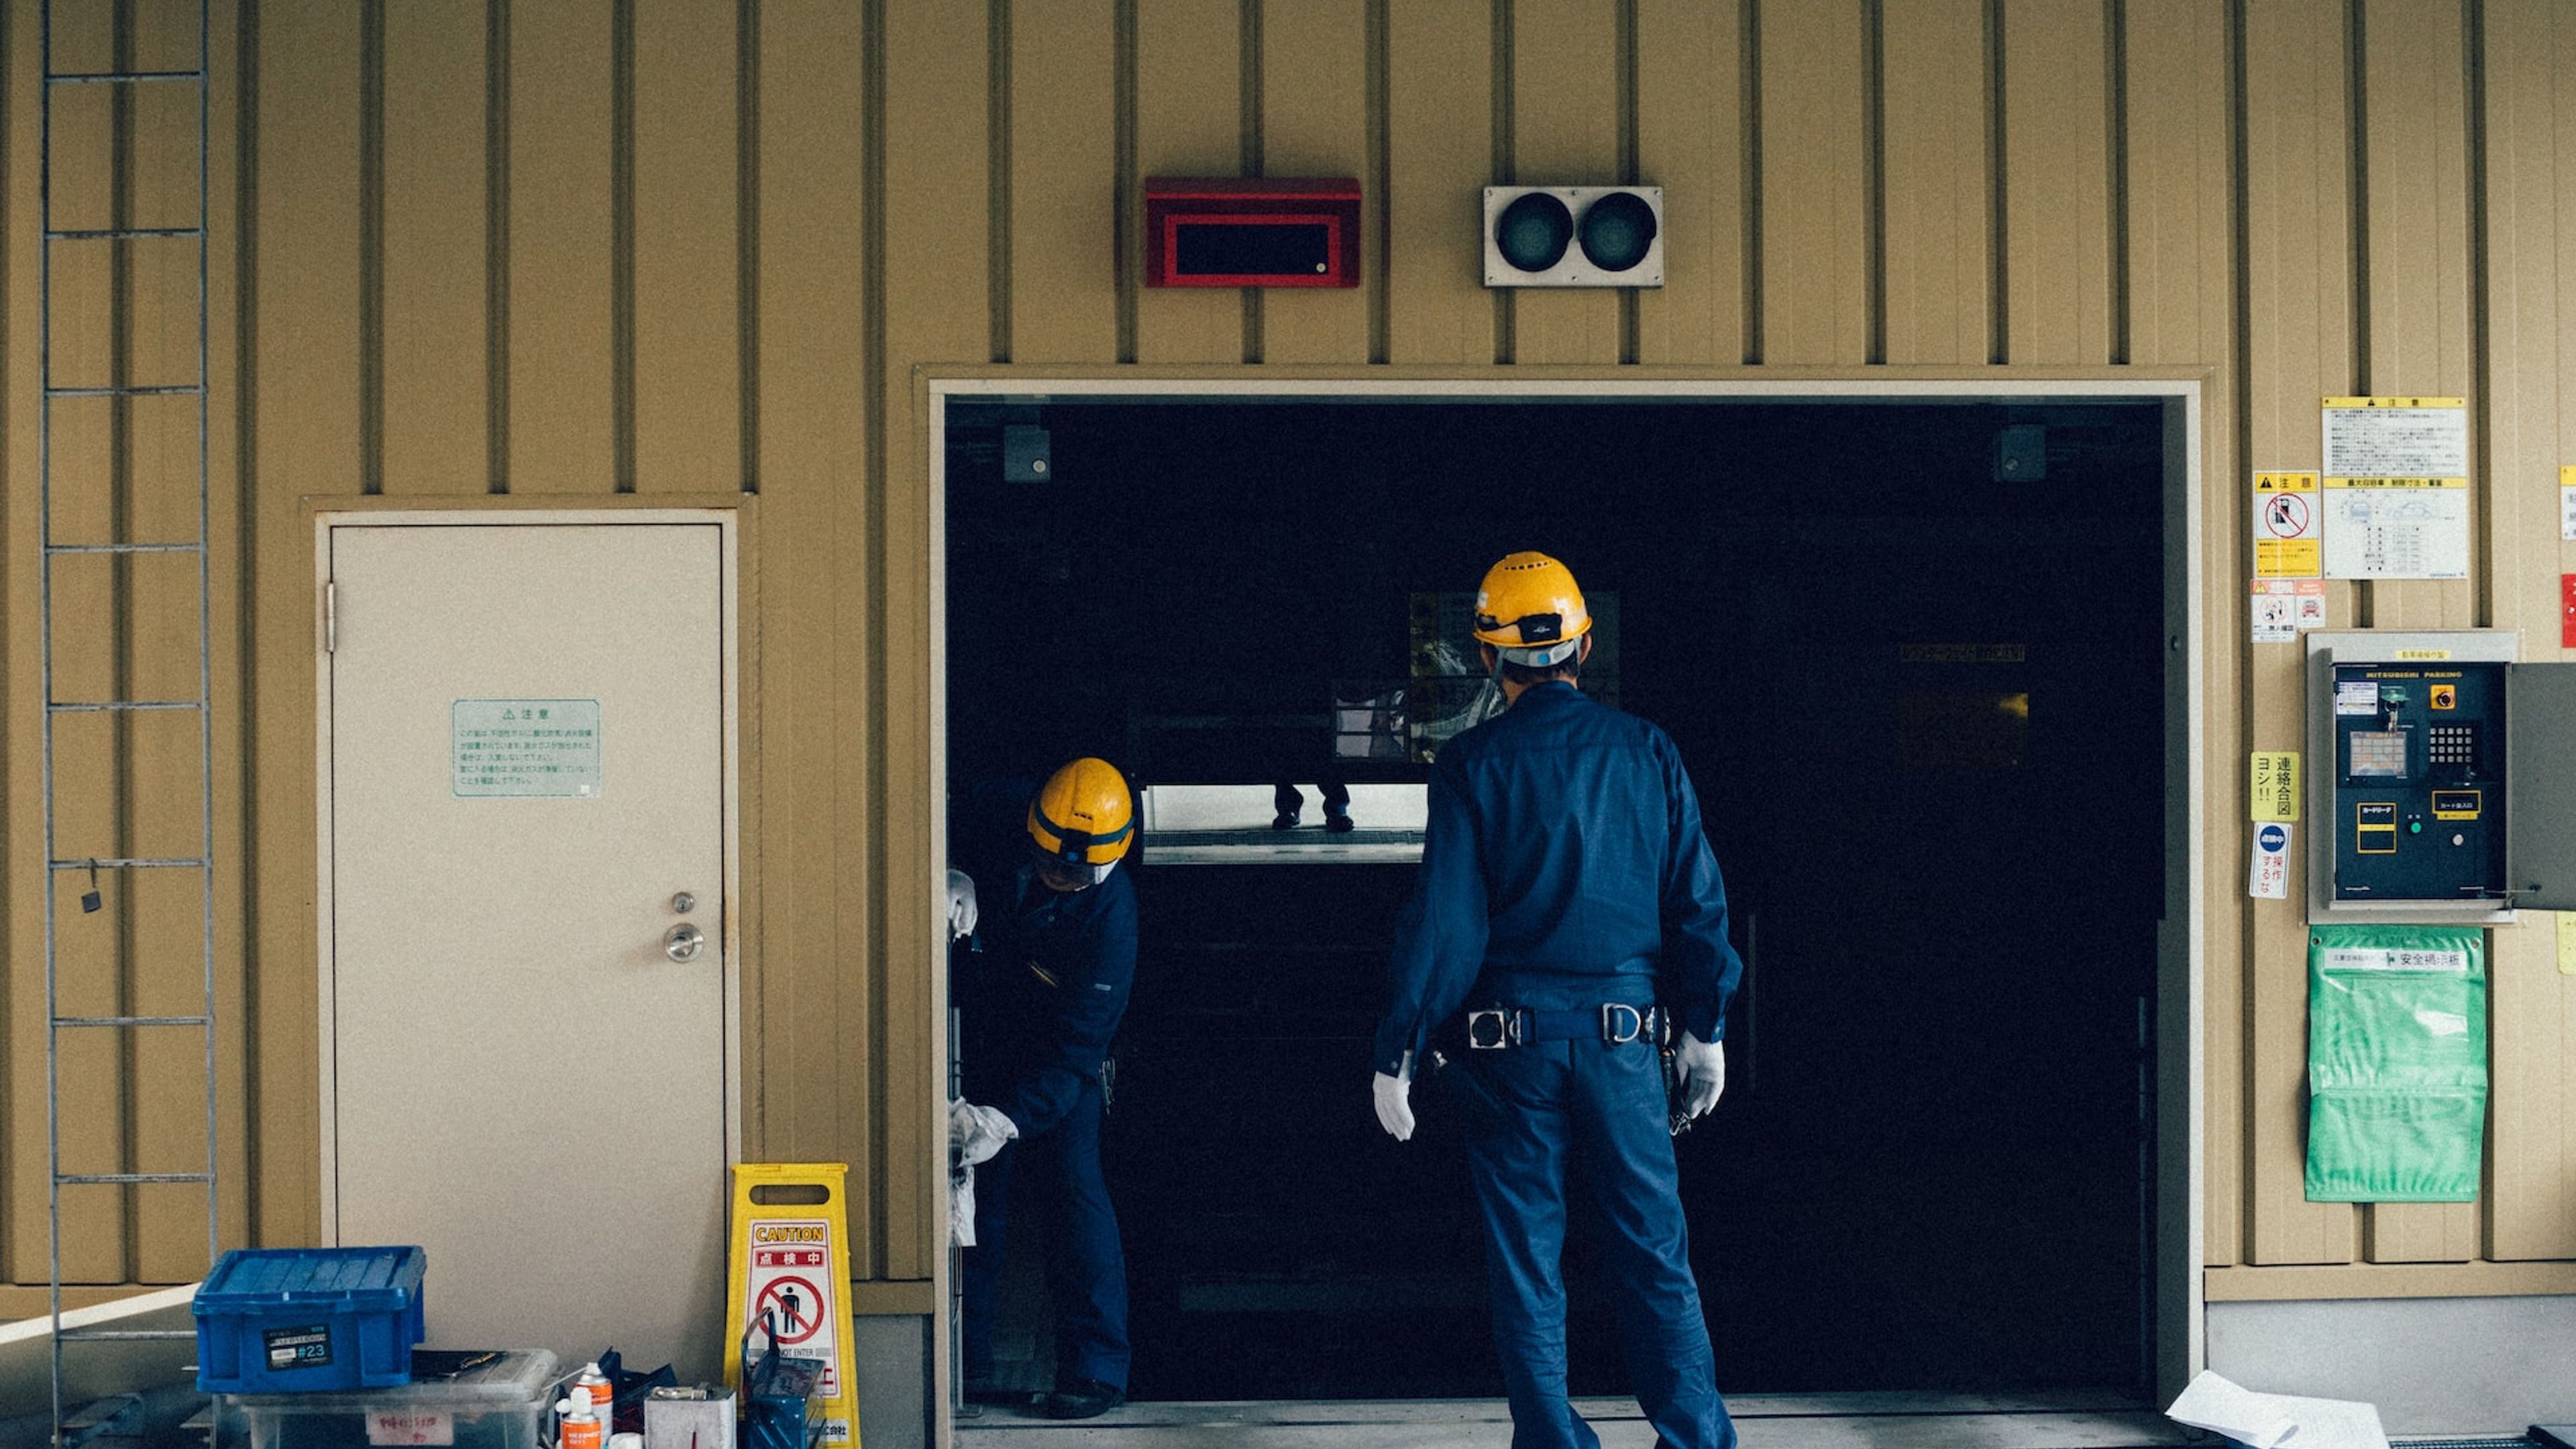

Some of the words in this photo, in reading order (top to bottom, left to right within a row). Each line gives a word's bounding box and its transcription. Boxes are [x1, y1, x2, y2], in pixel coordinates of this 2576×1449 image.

[2279, 477, 2312, 488] 注意
[521, 708, 549, 720] 注意
[2277, 757, 2291, 815] 連絡合図
[2261, 856, 2271, 893] するな
[2273, 856, 2282, 881] 操作
[2400, 953, 2460, 966] 安全掲示板
[755, 1226, 824, 1242] CAUTION
[759, 1252, 820, 1265] 点検中
[297, 1344, 325, 1358] #23
[794, 1348, 814, 1357] ENTER
